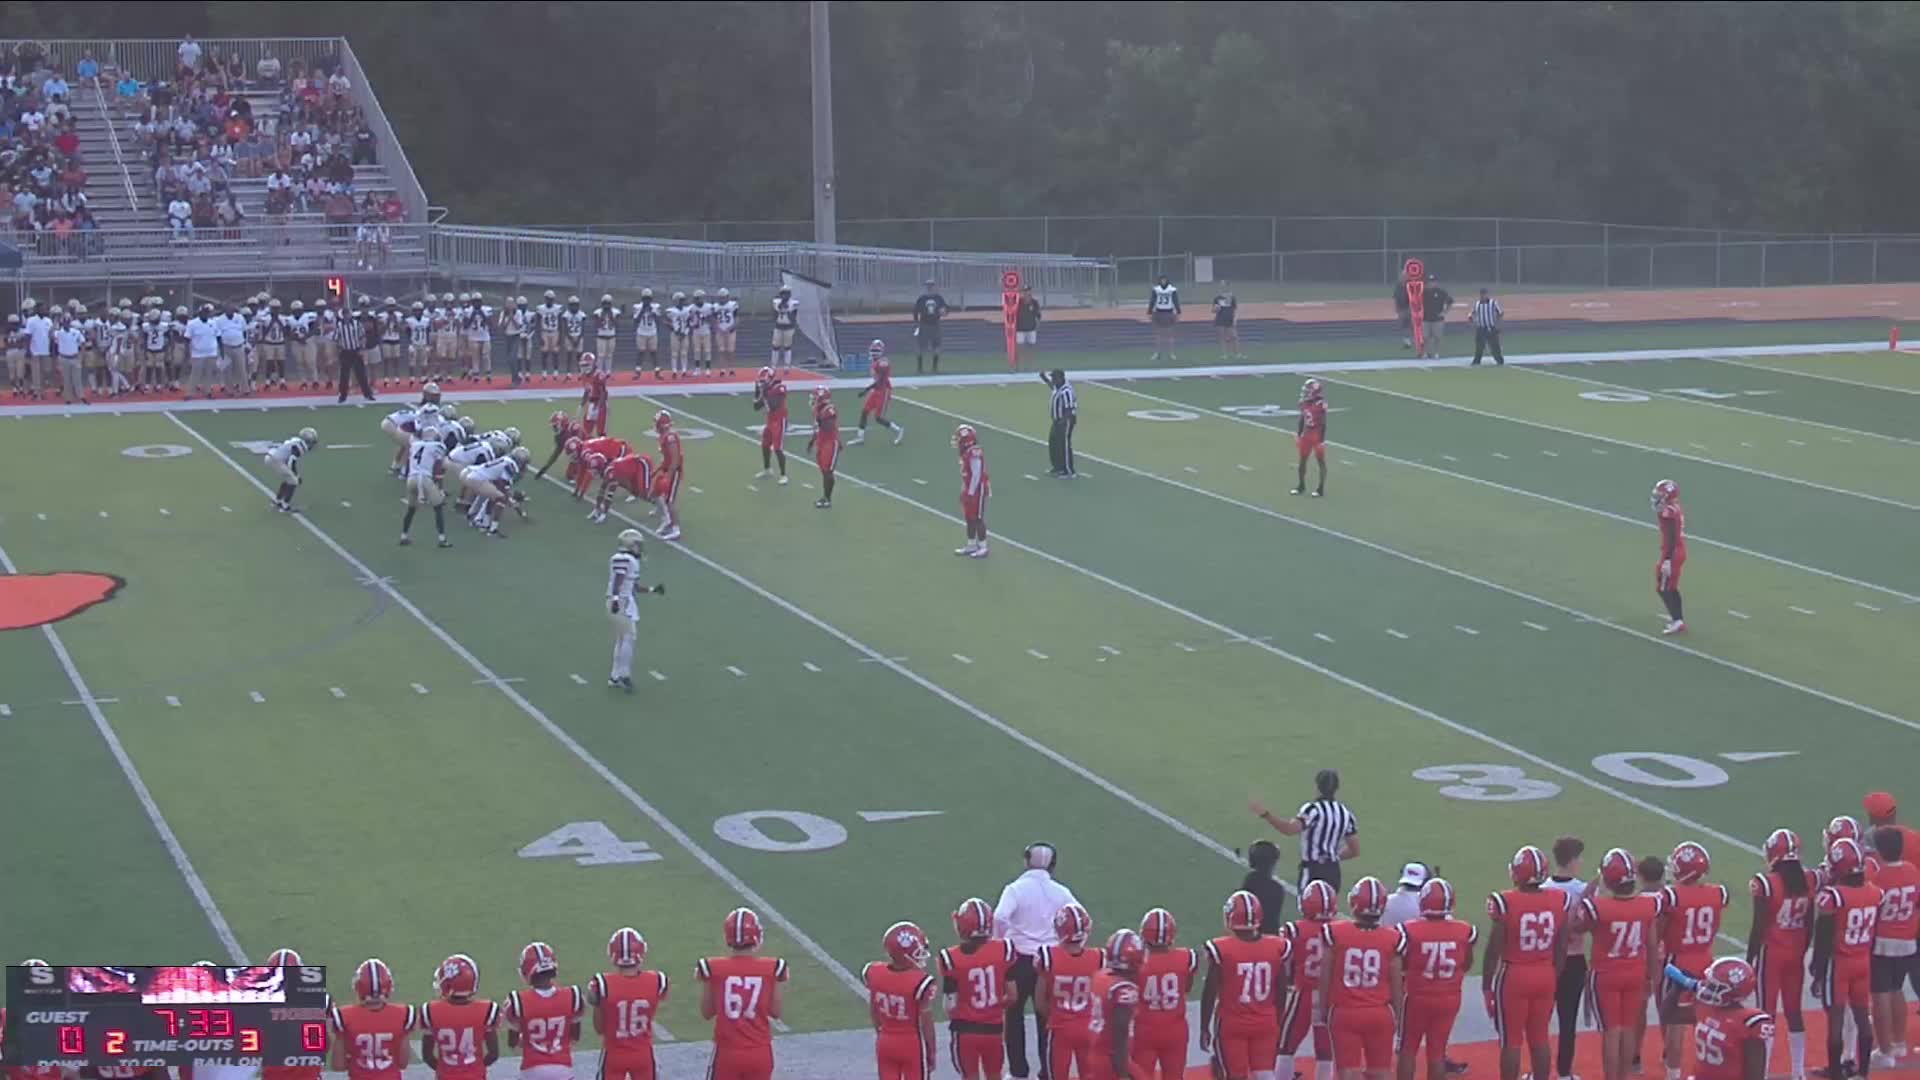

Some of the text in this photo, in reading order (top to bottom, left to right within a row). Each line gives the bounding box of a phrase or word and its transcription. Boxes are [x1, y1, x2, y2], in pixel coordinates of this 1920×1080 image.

[328, 277, 341, 297] 4
[413, 446, 420, 465] 4
[1776, 896, 1808, 929] 42
[1881, 885, 1916, 921] 65
[1519, 911, 1554, 951] 63
[1607, 920, 1642, 958] 74
[1682, 906, 1714, 944] 19
[1304, 937, 1322, 977] 2
[1421, 941, 1457, 980] 75
[724, 975, 763, 1020] 67
[968, 965, 999, 1009] 31
[1144, 972, 1180, 1010] 48
[1237, 961, 1271, 1004] 70
[527, 1016, 566, 1054] 27
[616, 999, 651, 1038] 16
[355, 1032, 394, 1070] 35
[437, 1026, 477, 1066] 24
[1695, 1021, 1727, 1066] 55
